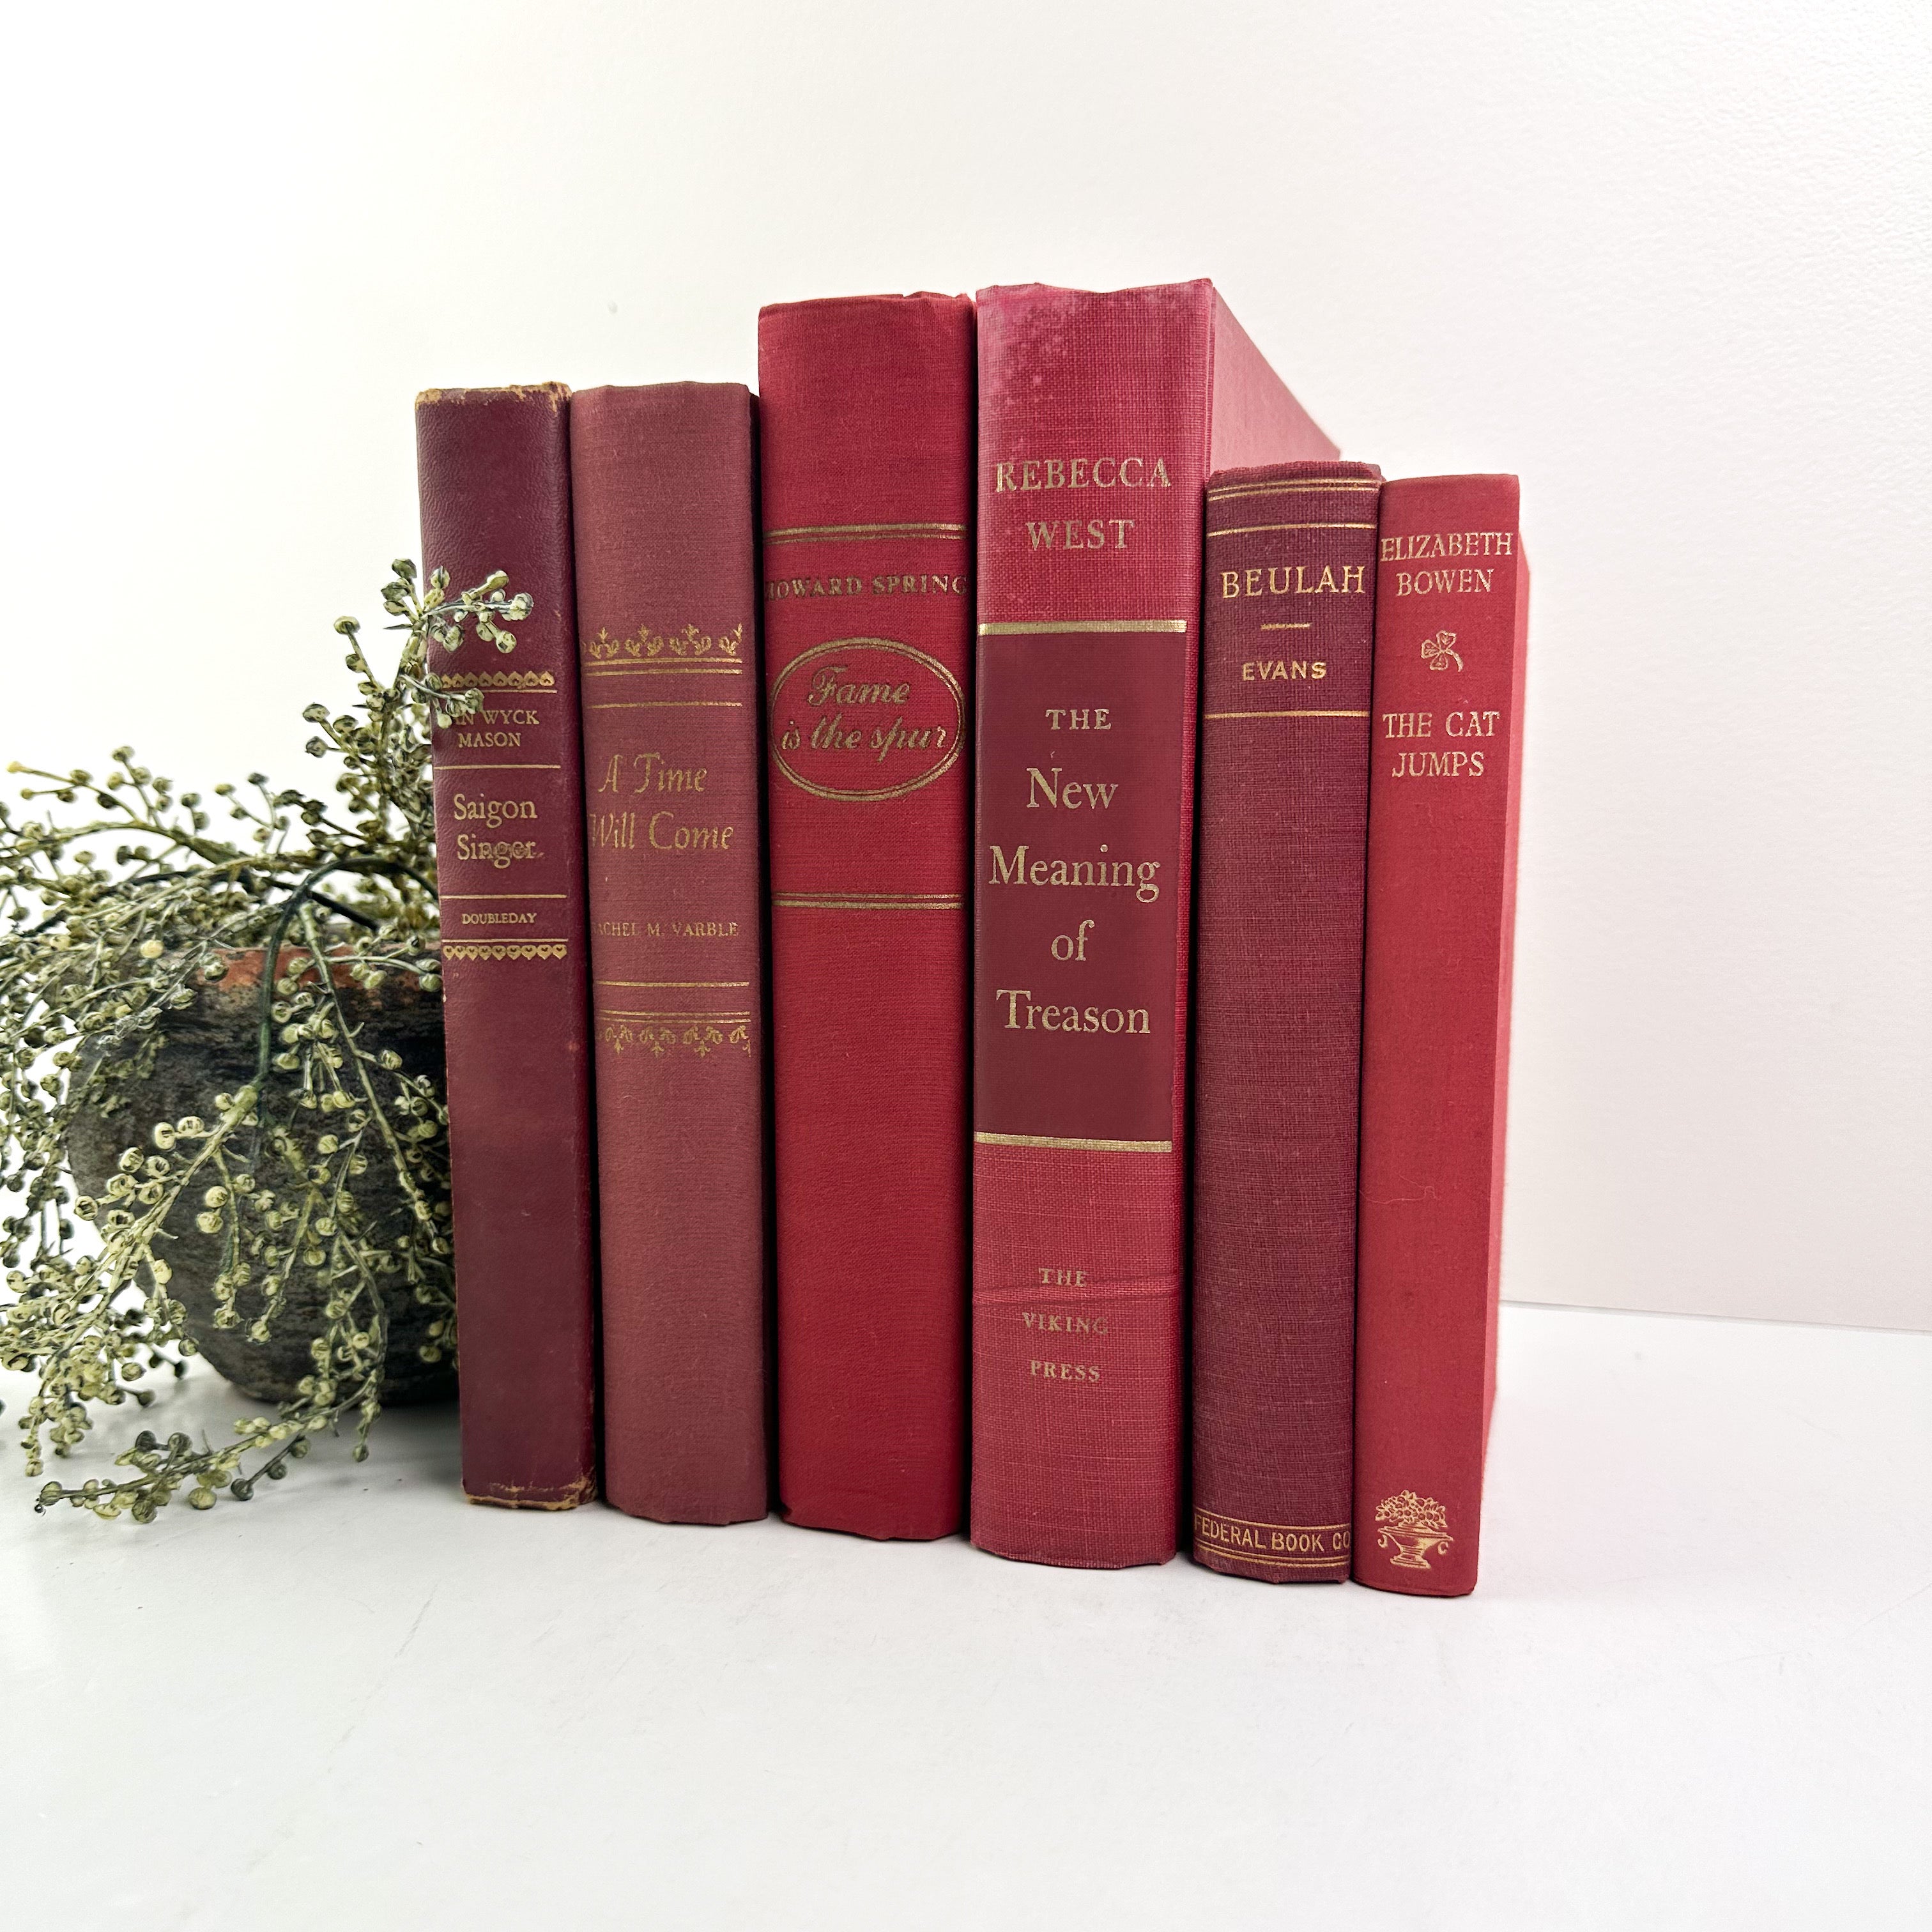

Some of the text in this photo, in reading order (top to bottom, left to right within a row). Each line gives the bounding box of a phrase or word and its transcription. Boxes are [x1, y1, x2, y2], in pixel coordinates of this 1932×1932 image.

[995, 457, 1171, 493] REBECCA
[1025, 519, 1135, 551] WEST
[1380, 532, 1513, 562] ELIZABETH
[871, 573, 967, 595] SPRING
[1221, 565, 1365, 599] BEULAH
[1396, 568, 1494, 596] BOWEN
[808, 665, 910, 707] Fame
[1243, 661, 1327, 680] EVANS
[480, 709, 540, 725] WYCK
[1045, 709, 1112, 730] THE
[1383, 711, 1500, 739] THE CAT
[458, 732, 521, 748] MASON
[781, 712, 948, 763] is the spur
[598, 751, 707, 793] A Time
[1392, 751, 1484, 778] JUMPS
[1027, 768, 1119, 809] New
[454, 793, 538, 829] Saigon
[588, 811, 733, 850] Will Come
[457, 834, 536, 869] Singer
[988, 843, 1161, 903] Meaning
[461, 912, 537, 924] DOUBLEDAY
[672, 922, 739, 937] VARBLE
[1051, 919, 1094, 962] of
[995, 990, 1151, 1034] Treason
[1038, 1268, 1087, 1287] THE
[1022, 1312, 1108, 1335] VIKING
[1030, 1359, 1100, 1383] PRESS
[1194, 1514, 1268, 1549] FEDERAL
[1271, 1532, 1324, 1553] BOOK
